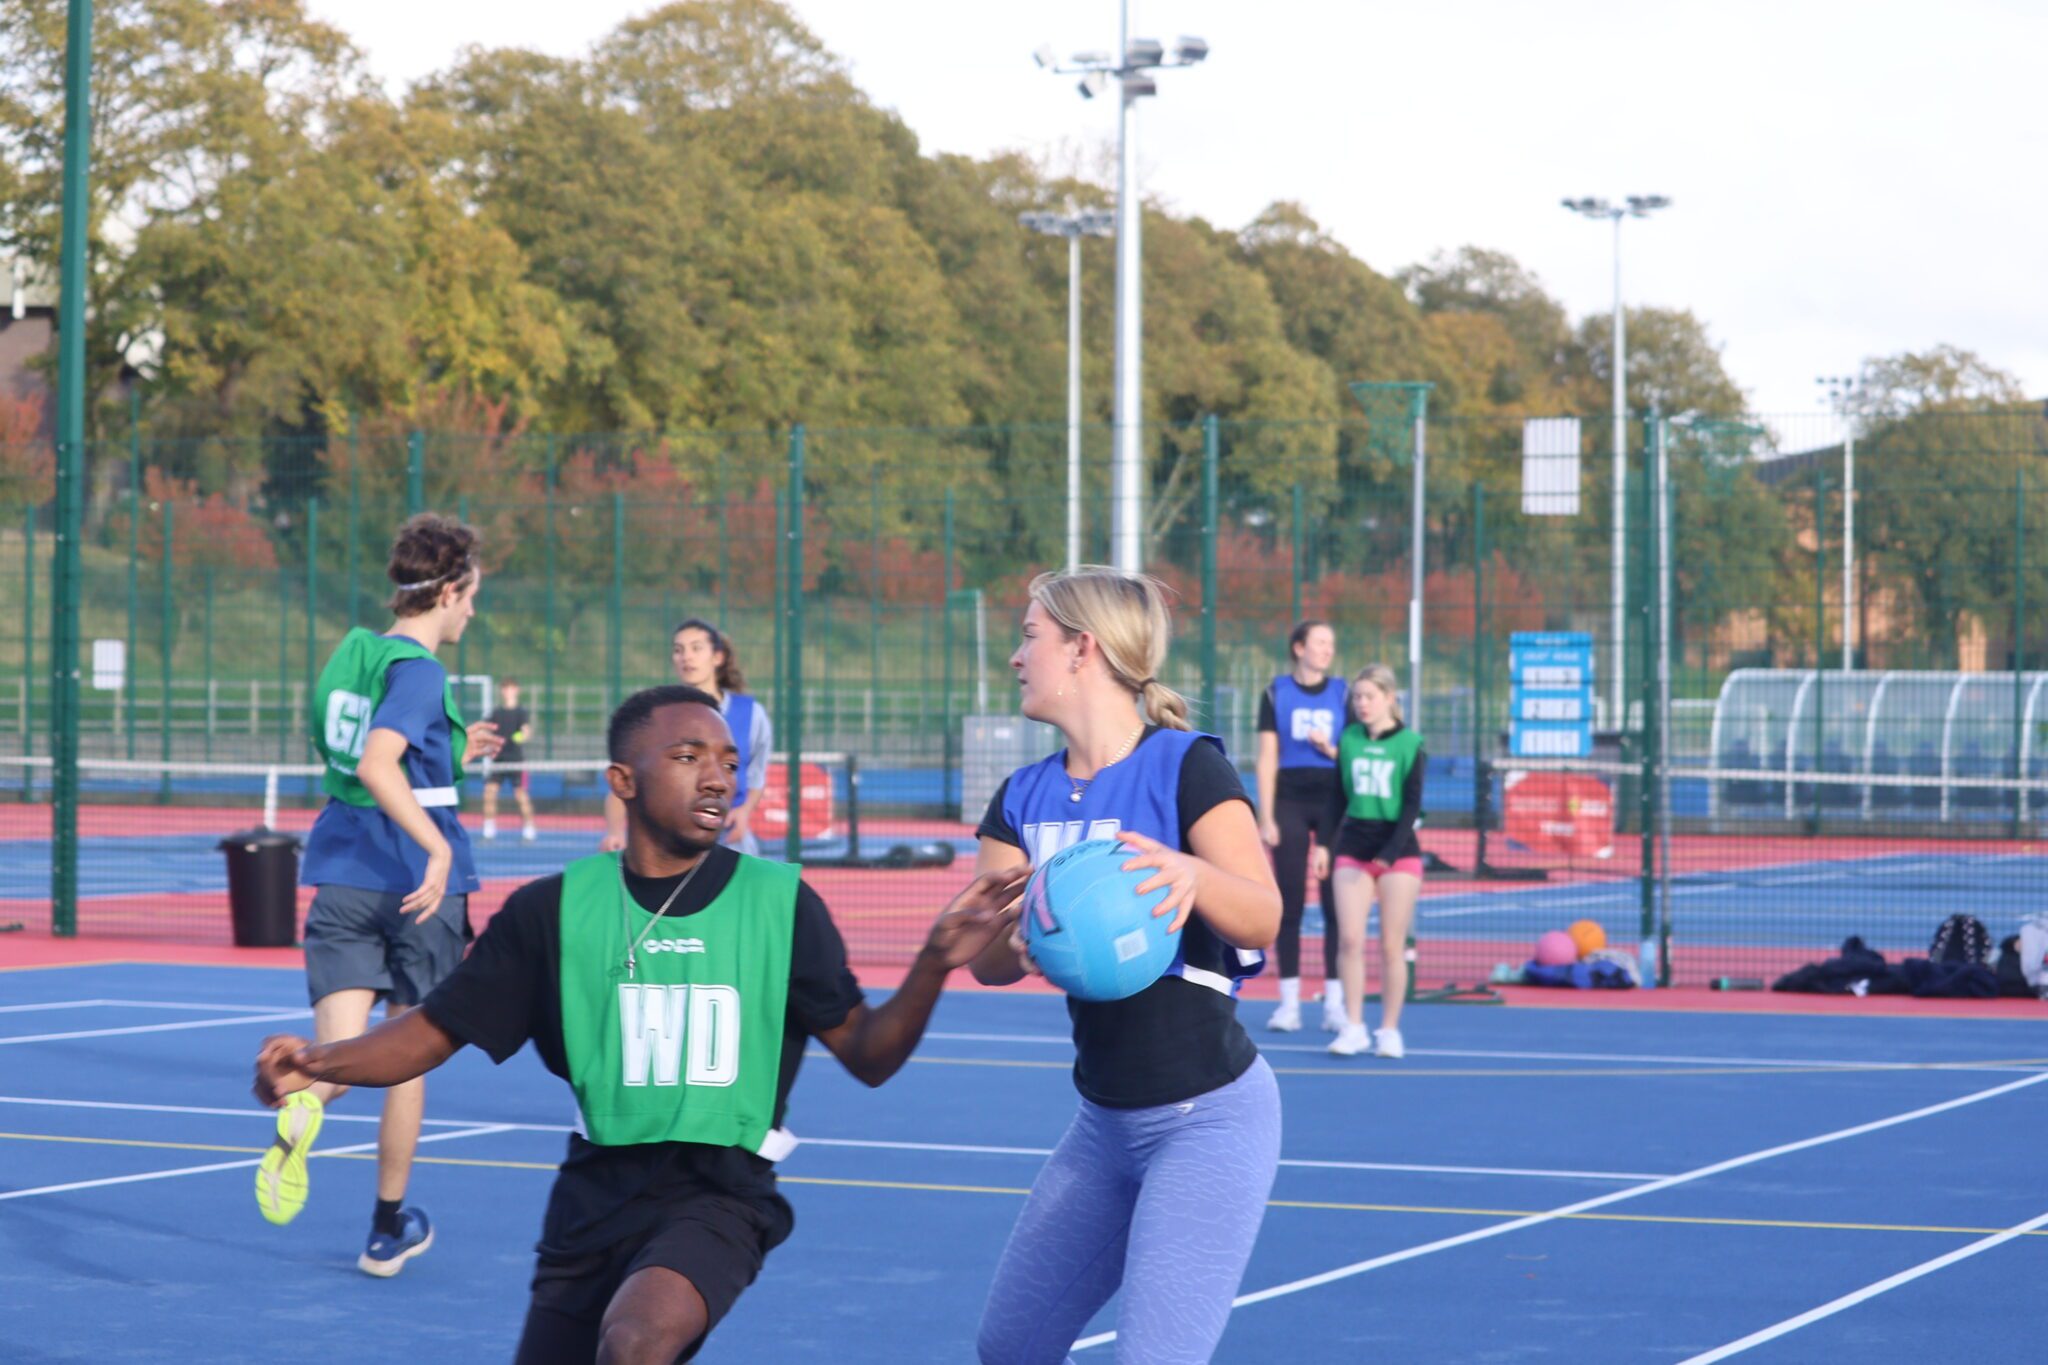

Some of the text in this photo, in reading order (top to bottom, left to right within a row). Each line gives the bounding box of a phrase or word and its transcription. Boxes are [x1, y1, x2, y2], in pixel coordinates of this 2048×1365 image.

[1291, 708, 1334, 741] GS
[1352, 757, 1395, 799] GK
[617, 982, 741, 1088] WD
